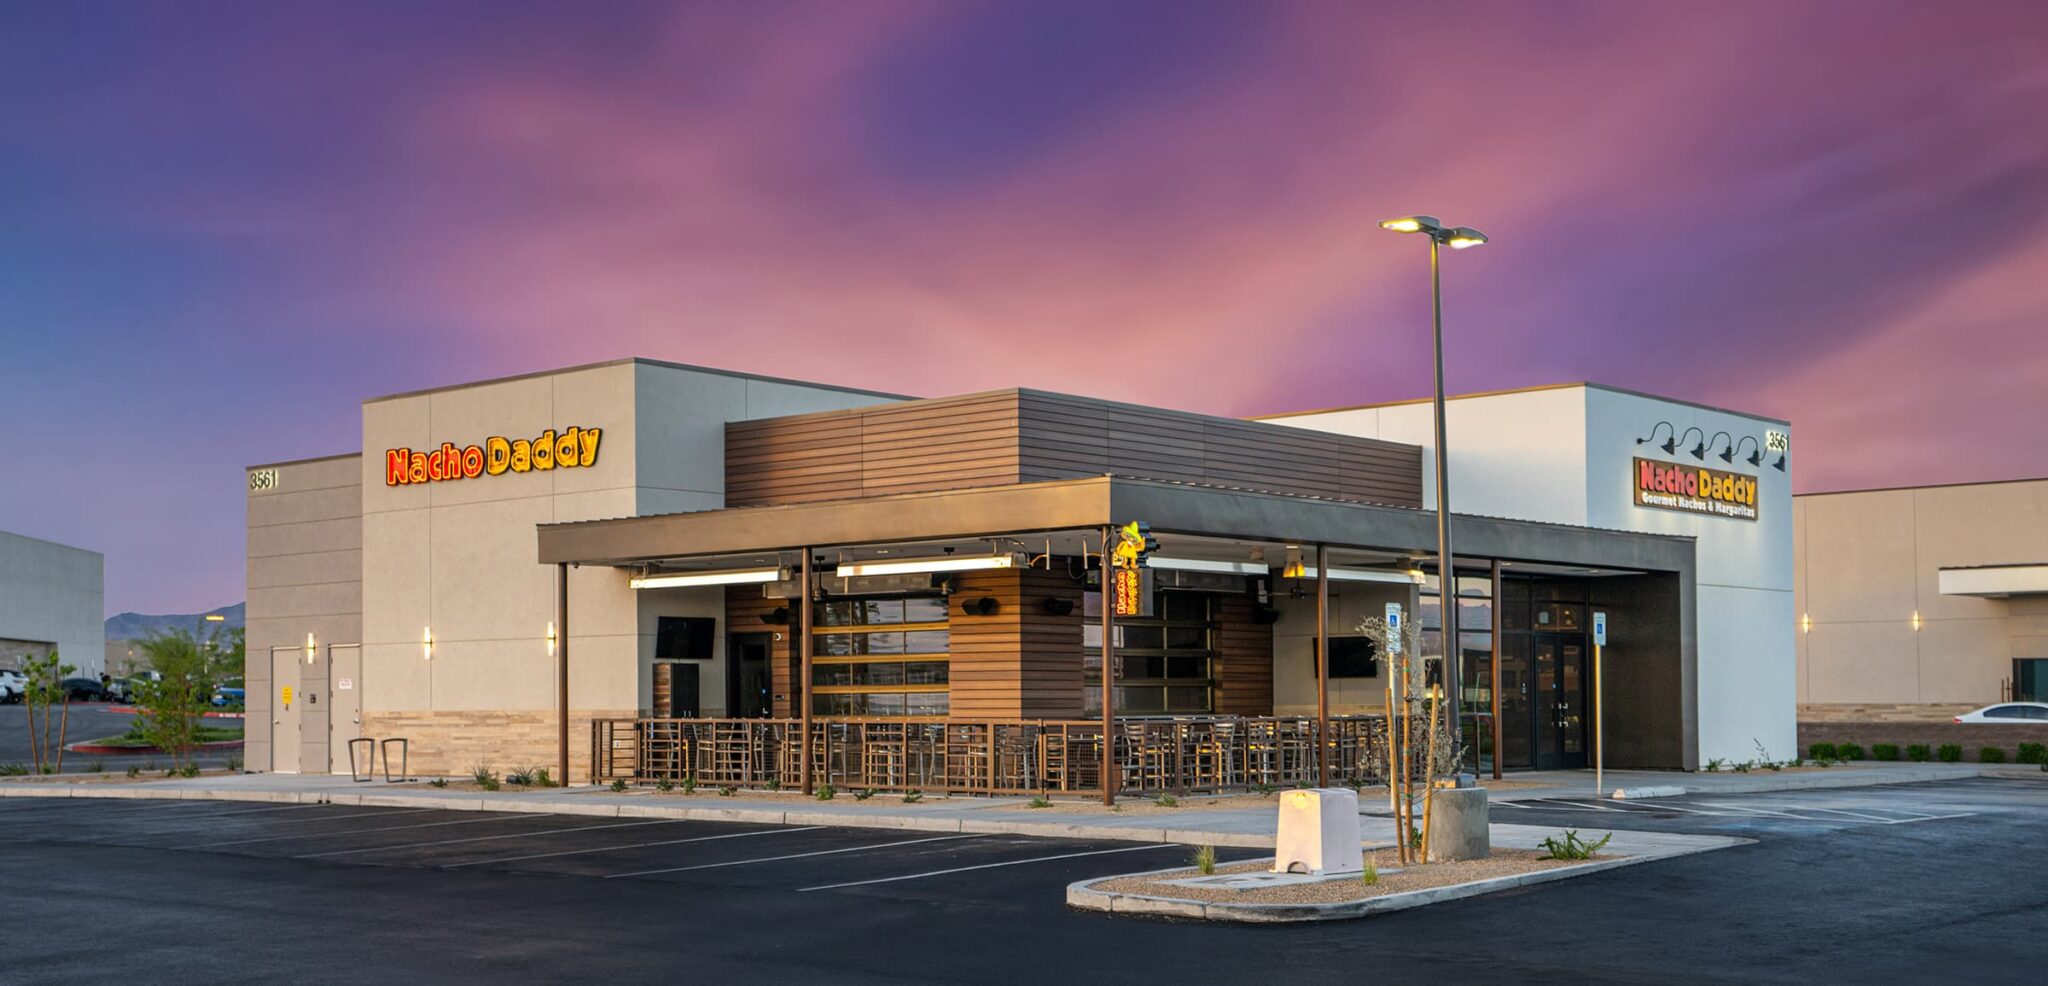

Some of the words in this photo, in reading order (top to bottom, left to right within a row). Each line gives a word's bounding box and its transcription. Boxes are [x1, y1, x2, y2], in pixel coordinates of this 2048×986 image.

[386, 442, 482, 486] Nacho
[487, 427, 602, 475] Daddy
[1769, 431, 1789, 451] 3561
[250, 470, 278, 489] 3561
[1640, 461, 1697, 496] Nacho
[1699, 470, 1755, 505] Daddy
[1642, 492, 1677, 507] Gourmet
[1678, 498, 1706, 511] Nachos
[1715, 502, 1755, 517] Margaritas
[1117, 571, 1126, 614] Nacho
